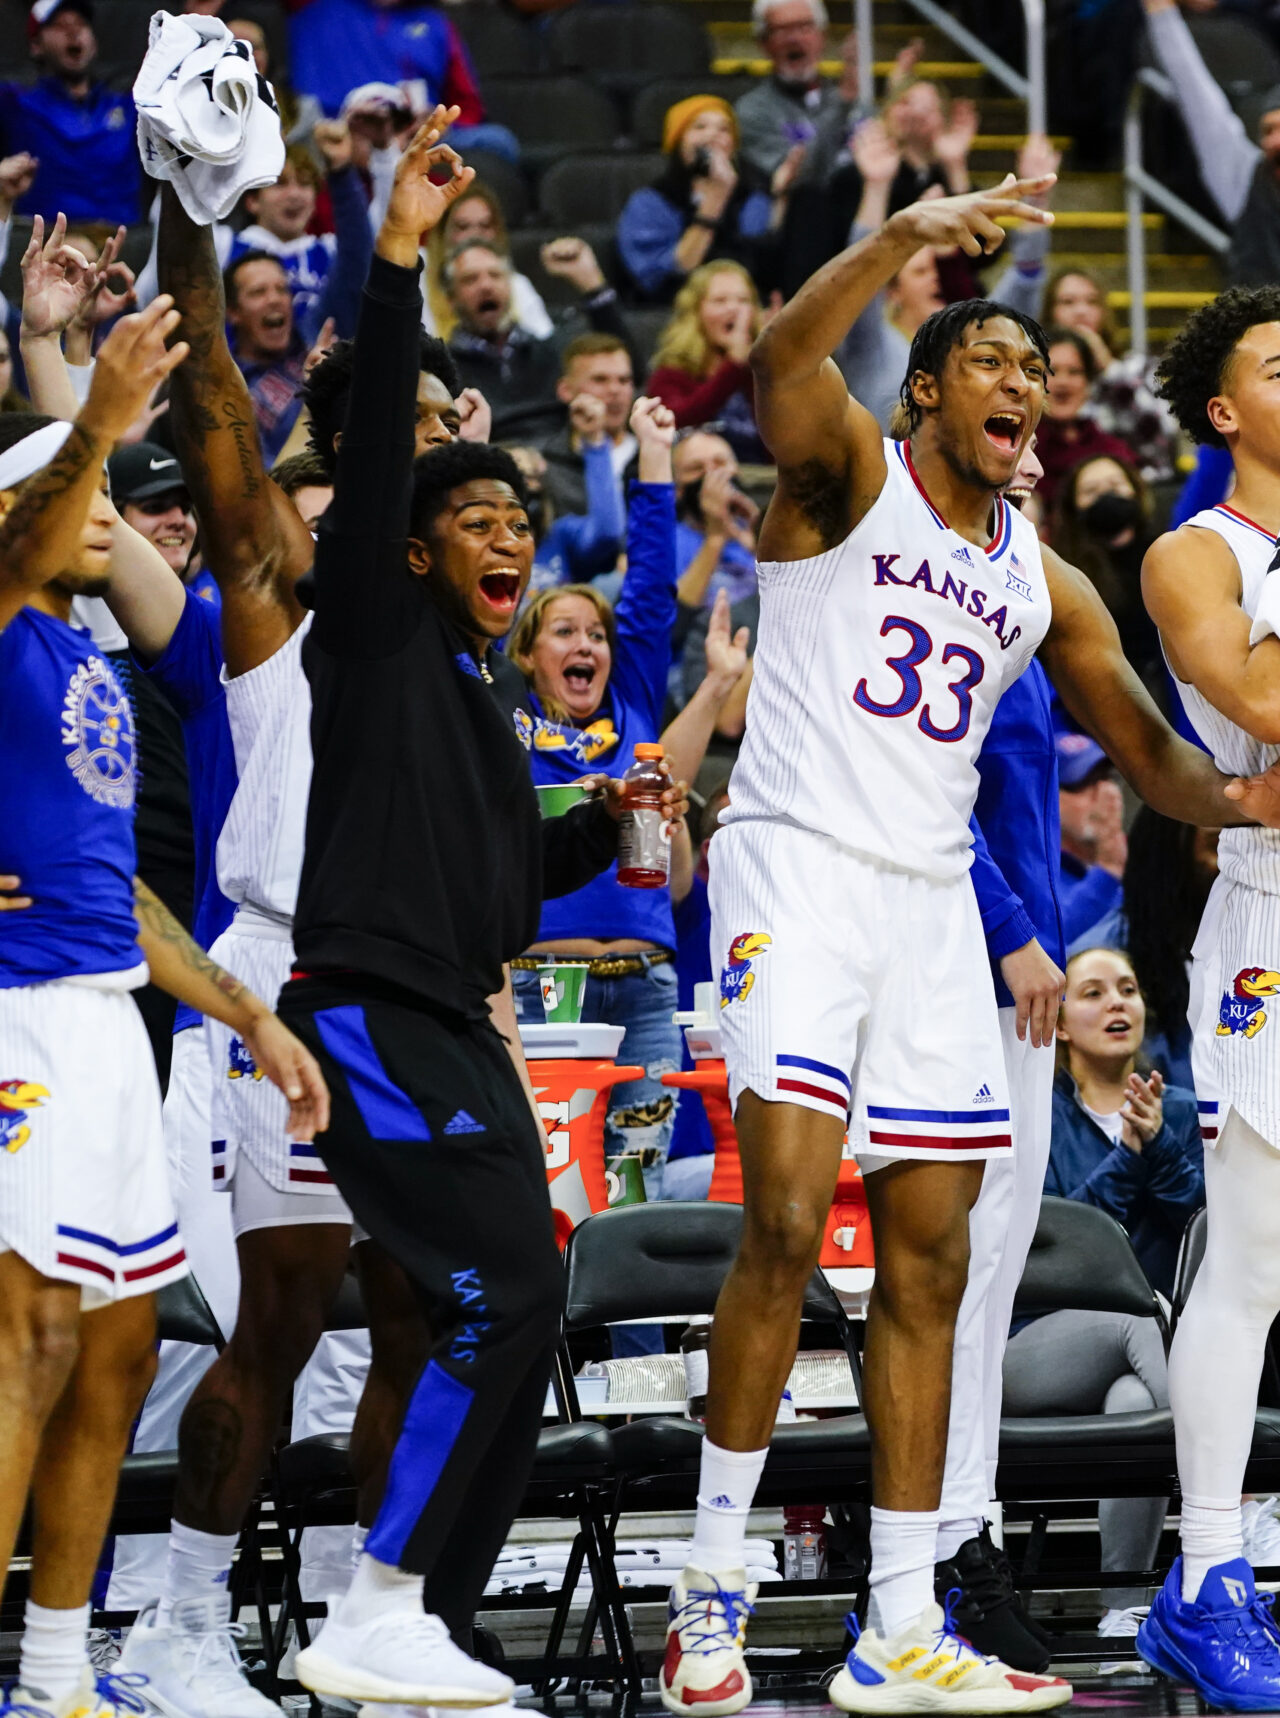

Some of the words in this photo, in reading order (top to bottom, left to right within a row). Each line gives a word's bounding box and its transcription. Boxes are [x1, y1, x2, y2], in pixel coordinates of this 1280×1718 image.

[871, 554, 1022, 650] KANSAS
[853, 615, 985, 743] 33
[1230, 1004, 1248, 1019] KU
